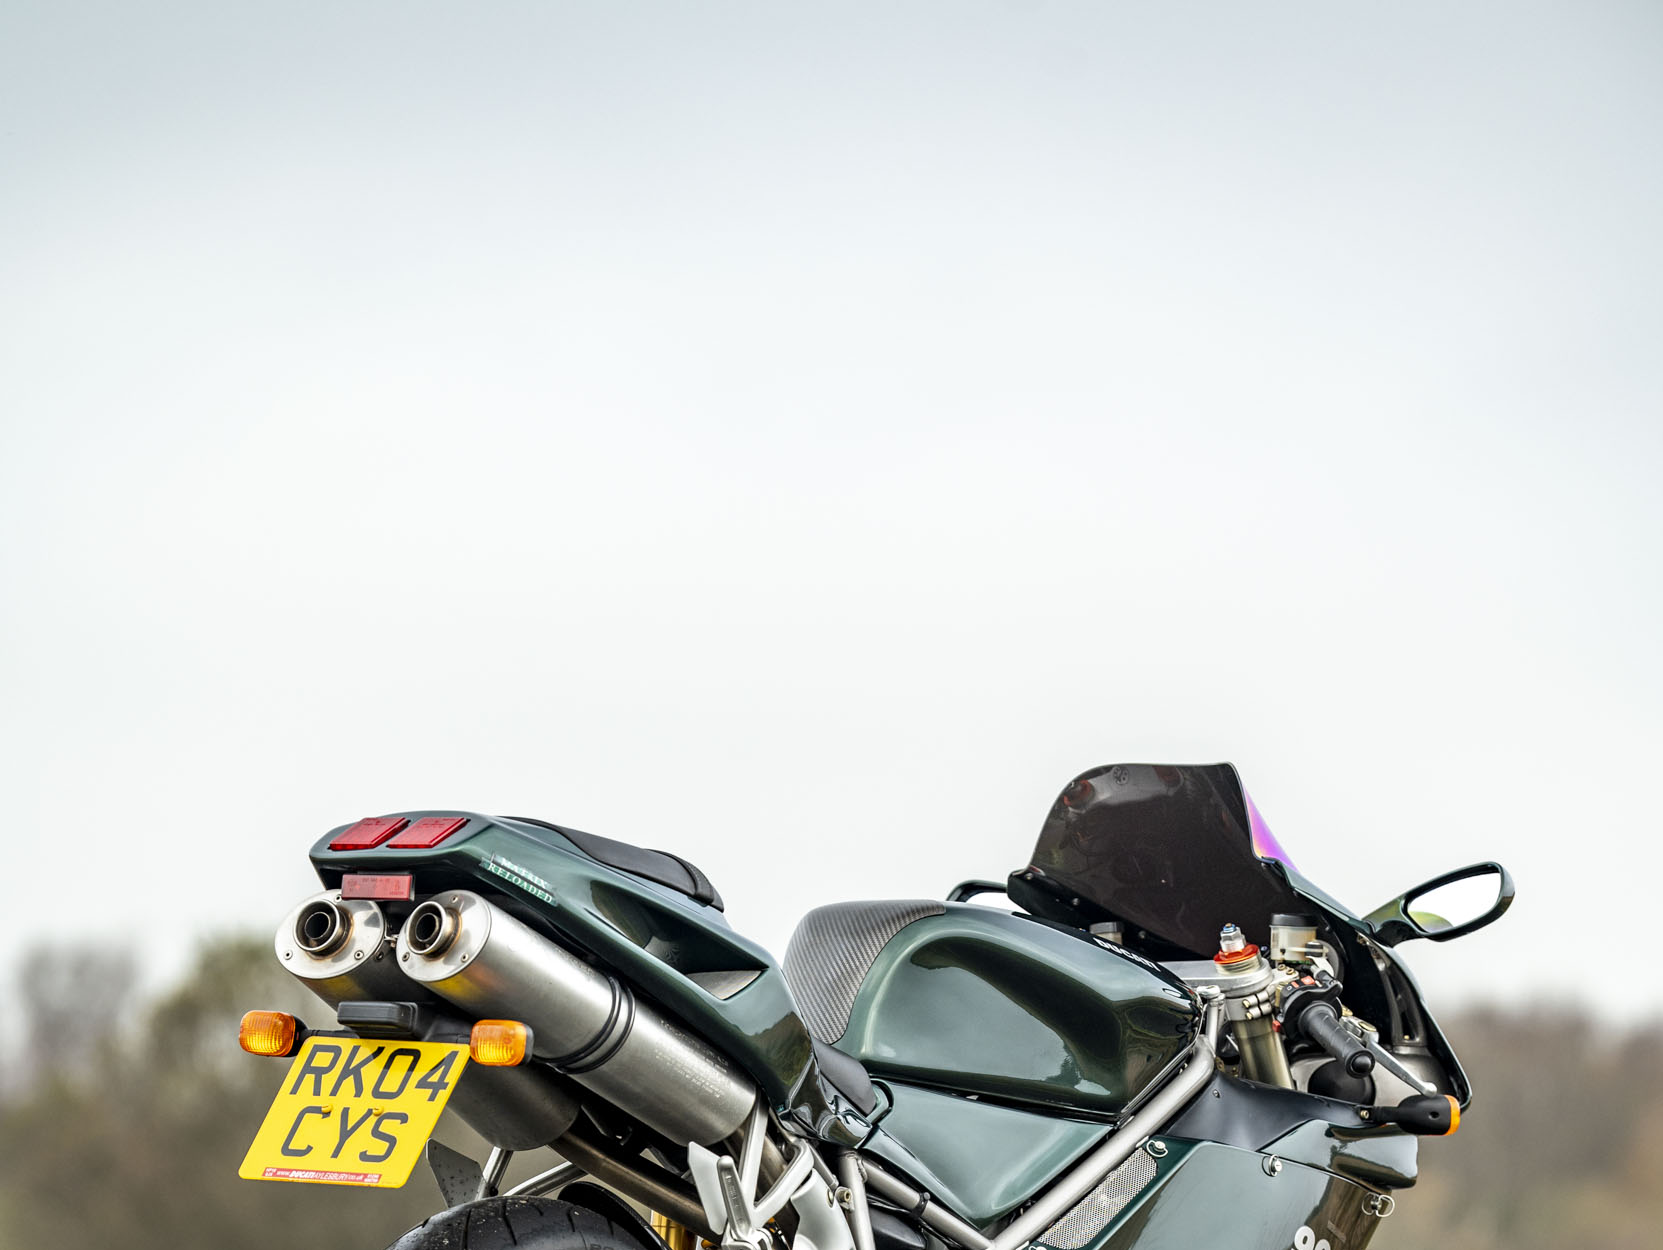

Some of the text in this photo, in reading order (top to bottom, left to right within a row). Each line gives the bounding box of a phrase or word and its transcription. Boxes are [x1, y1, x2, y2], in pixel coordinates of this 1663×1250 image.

[488, 860, 553, 904] RELOADED
[289, 1044, 459, 1102] RK04
[281, 1105, 409, 1163] CYS
